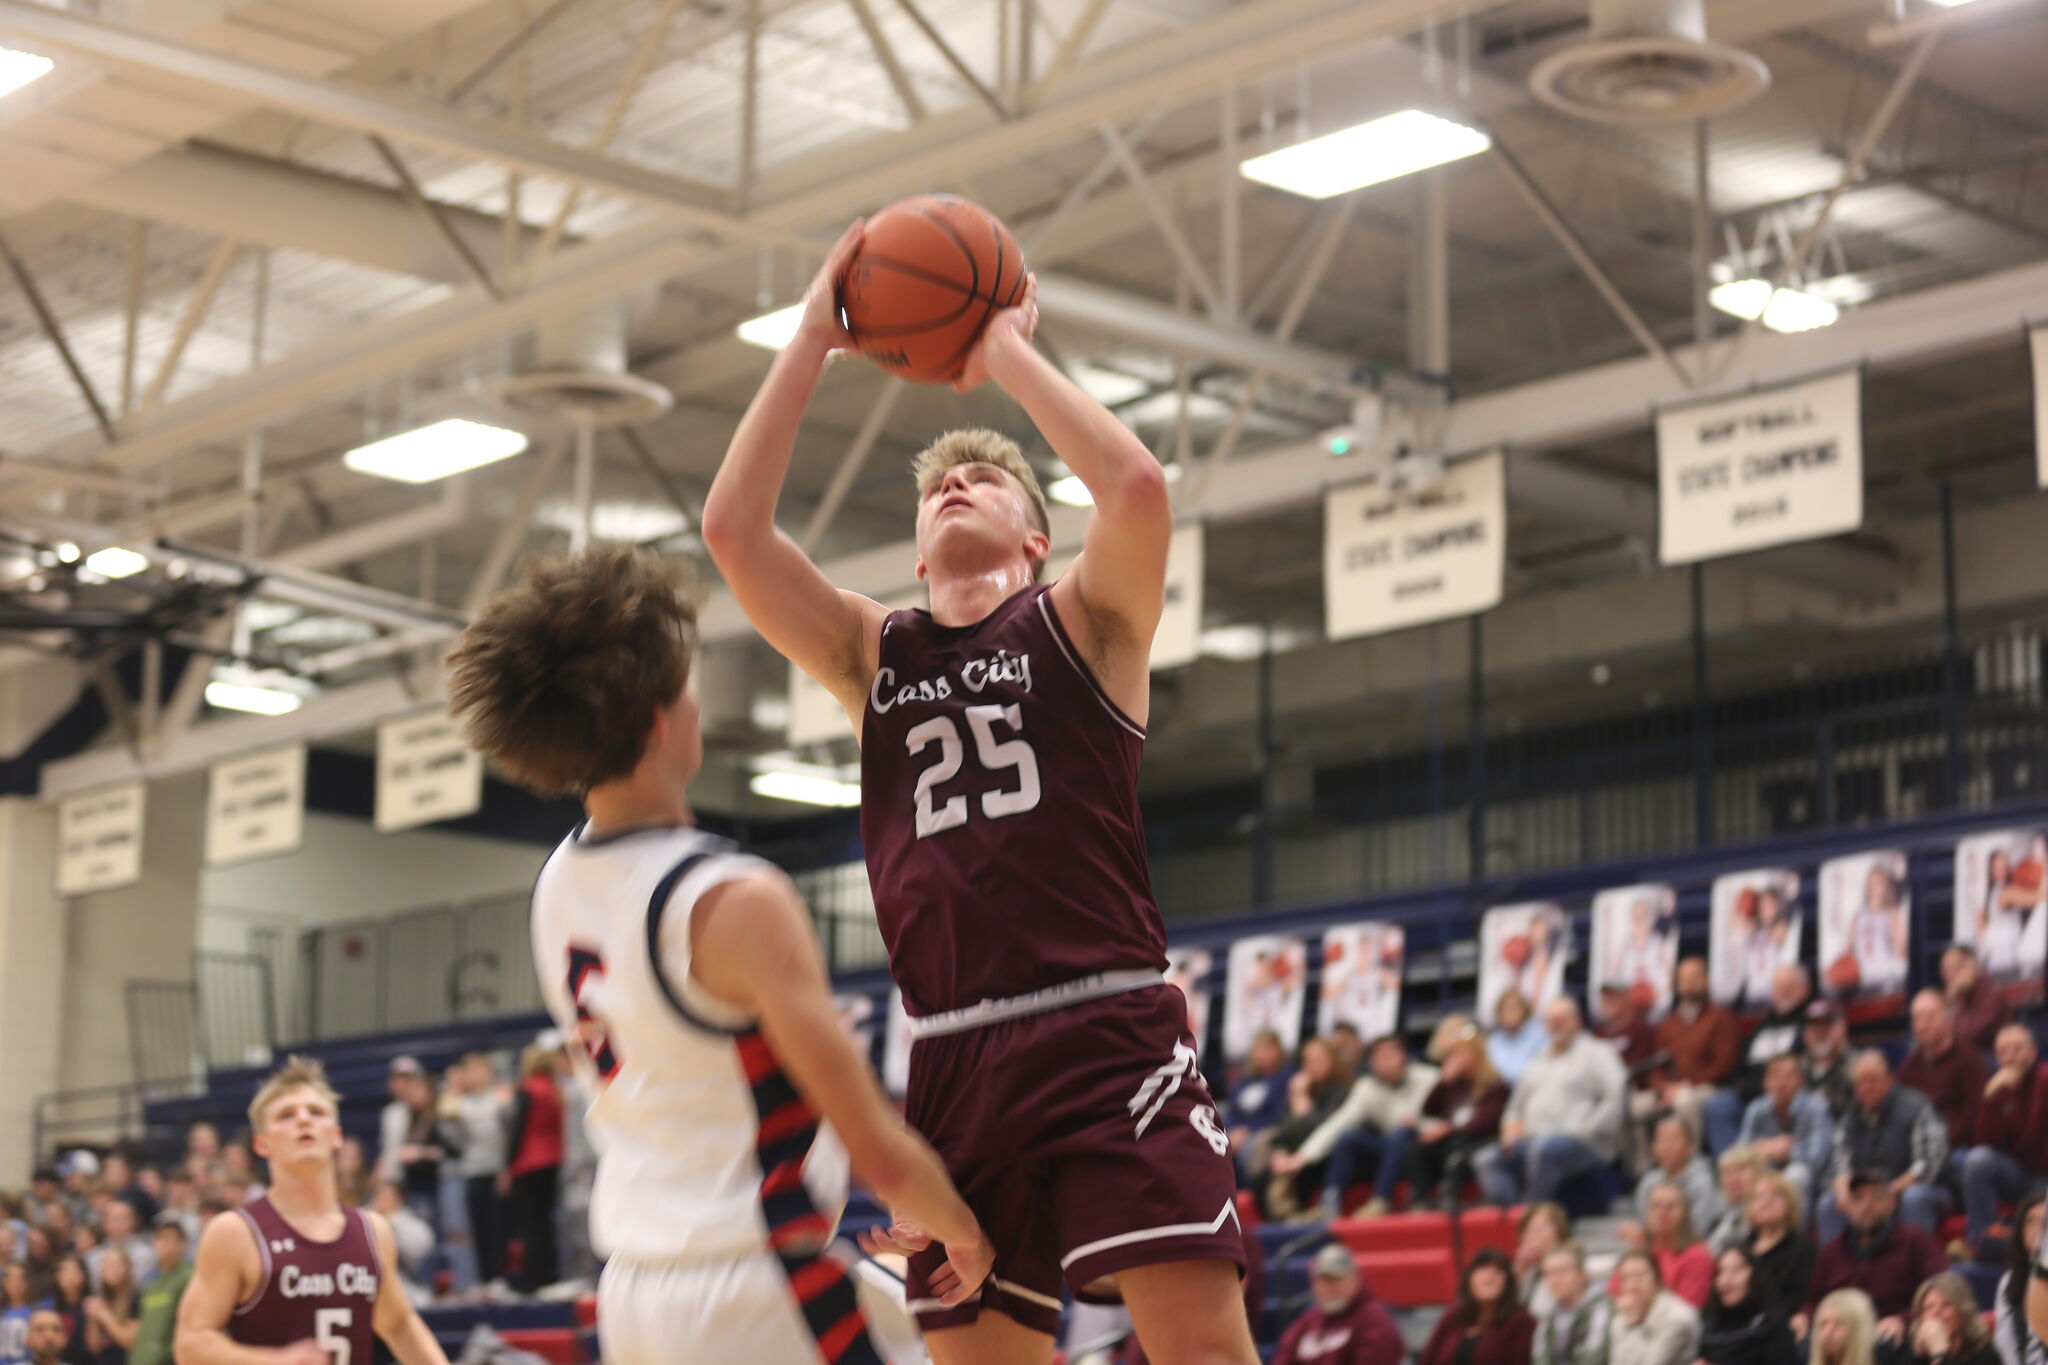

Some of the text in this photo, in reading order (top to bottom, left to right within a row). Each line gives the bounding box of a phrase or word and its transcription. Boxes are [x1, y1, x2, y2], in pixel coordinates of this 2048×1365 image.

[871, 649, 1032, 714] Cass City
[905, 702, 1041, 840] 25
[279, 1262, 376, 1301] Cass City
[314, 1308, 353, 1365] 5
